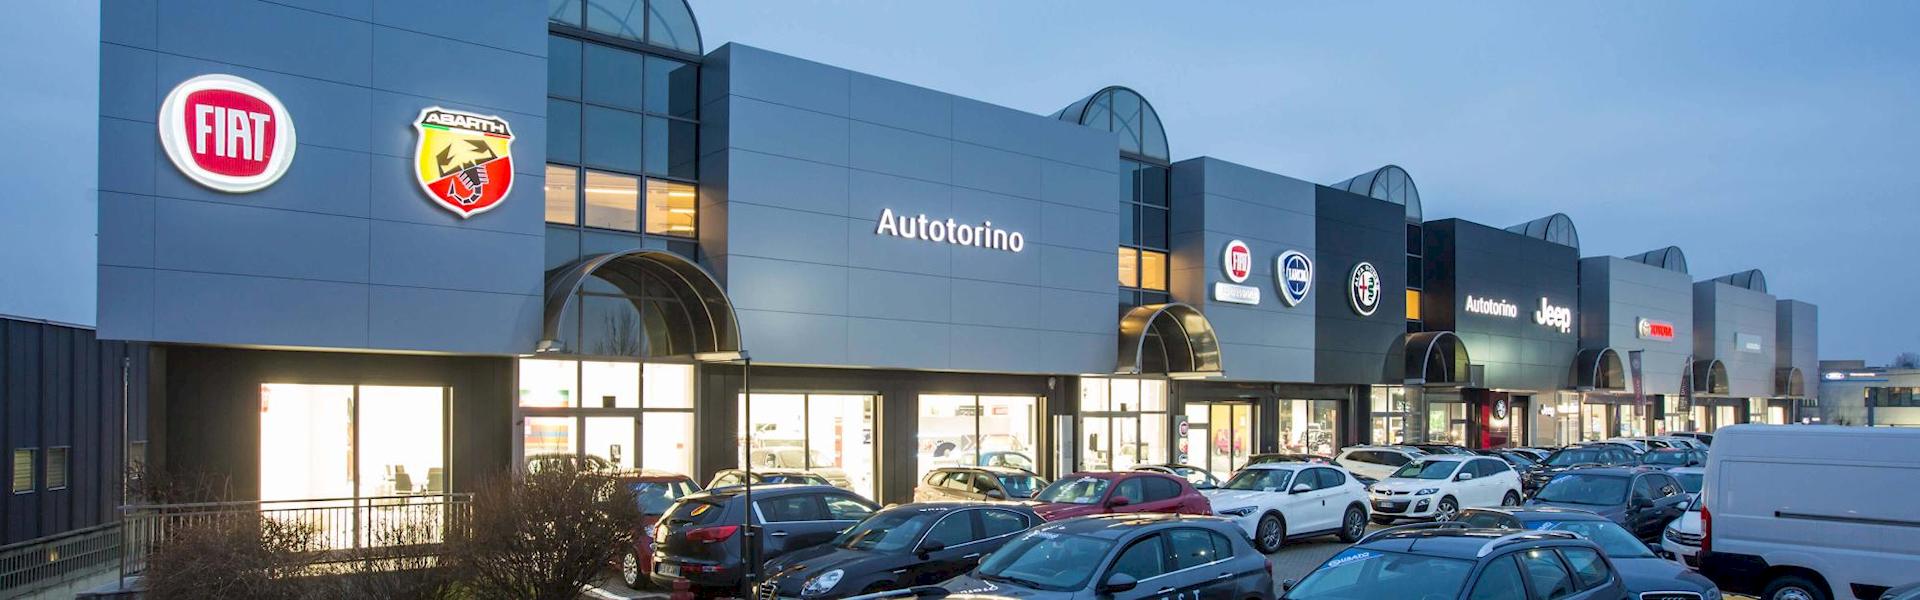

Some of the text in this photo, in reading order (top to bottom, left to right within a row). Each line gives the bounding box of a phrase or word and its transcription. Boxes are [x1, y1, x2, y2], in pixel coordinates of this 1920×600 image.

[195, 103, 271, 162] FIAT
[425, 113, 505, 133] ABARTH
[876, 208, 1024, 252] Autotorino
[1465, 295, 1517, 318] Autotorino
[1536, 297, 1571, 333] Jeep
